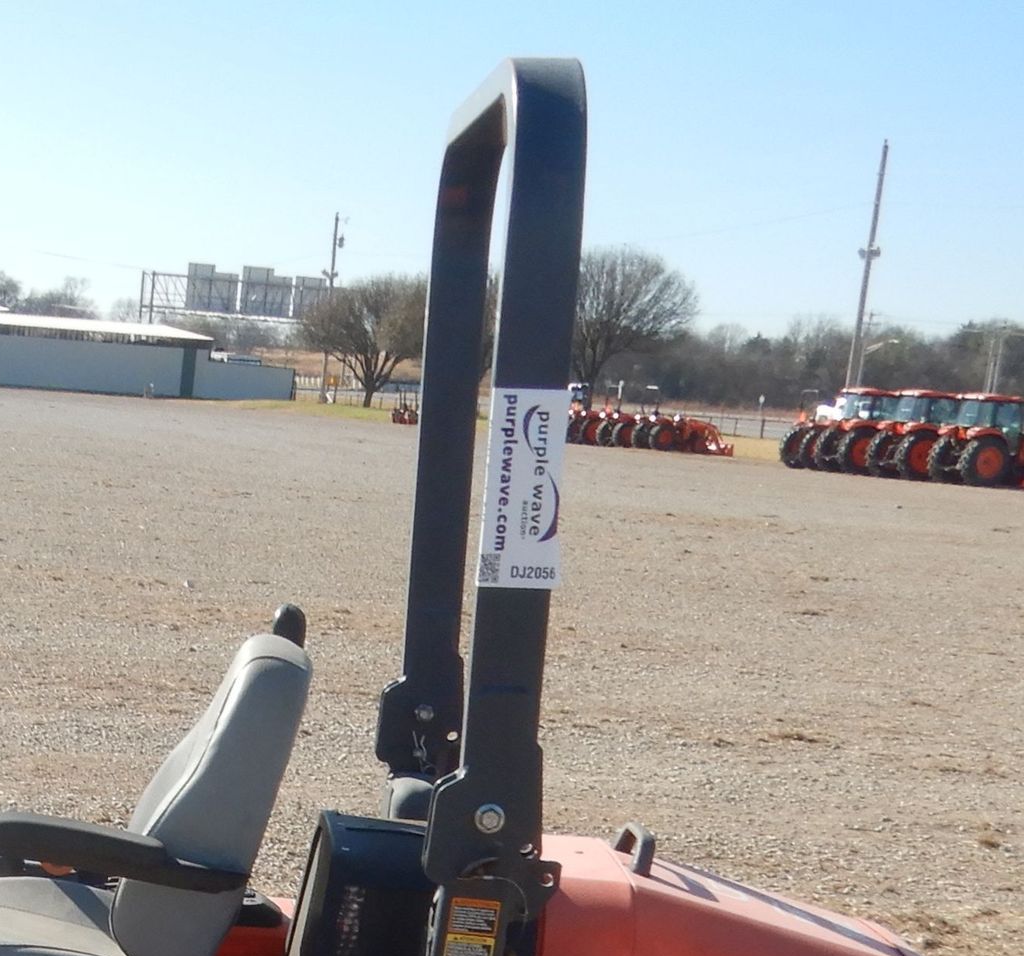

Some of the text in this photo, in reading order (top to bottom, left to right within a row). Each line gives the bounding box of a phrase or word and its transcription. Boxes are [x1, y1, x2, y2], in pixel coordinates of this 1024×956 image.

[494, 394, 518, 551] purplewave.com
[529, 411, 550, 537] purple wave
[510, 565, 556, 580] DJ2056
